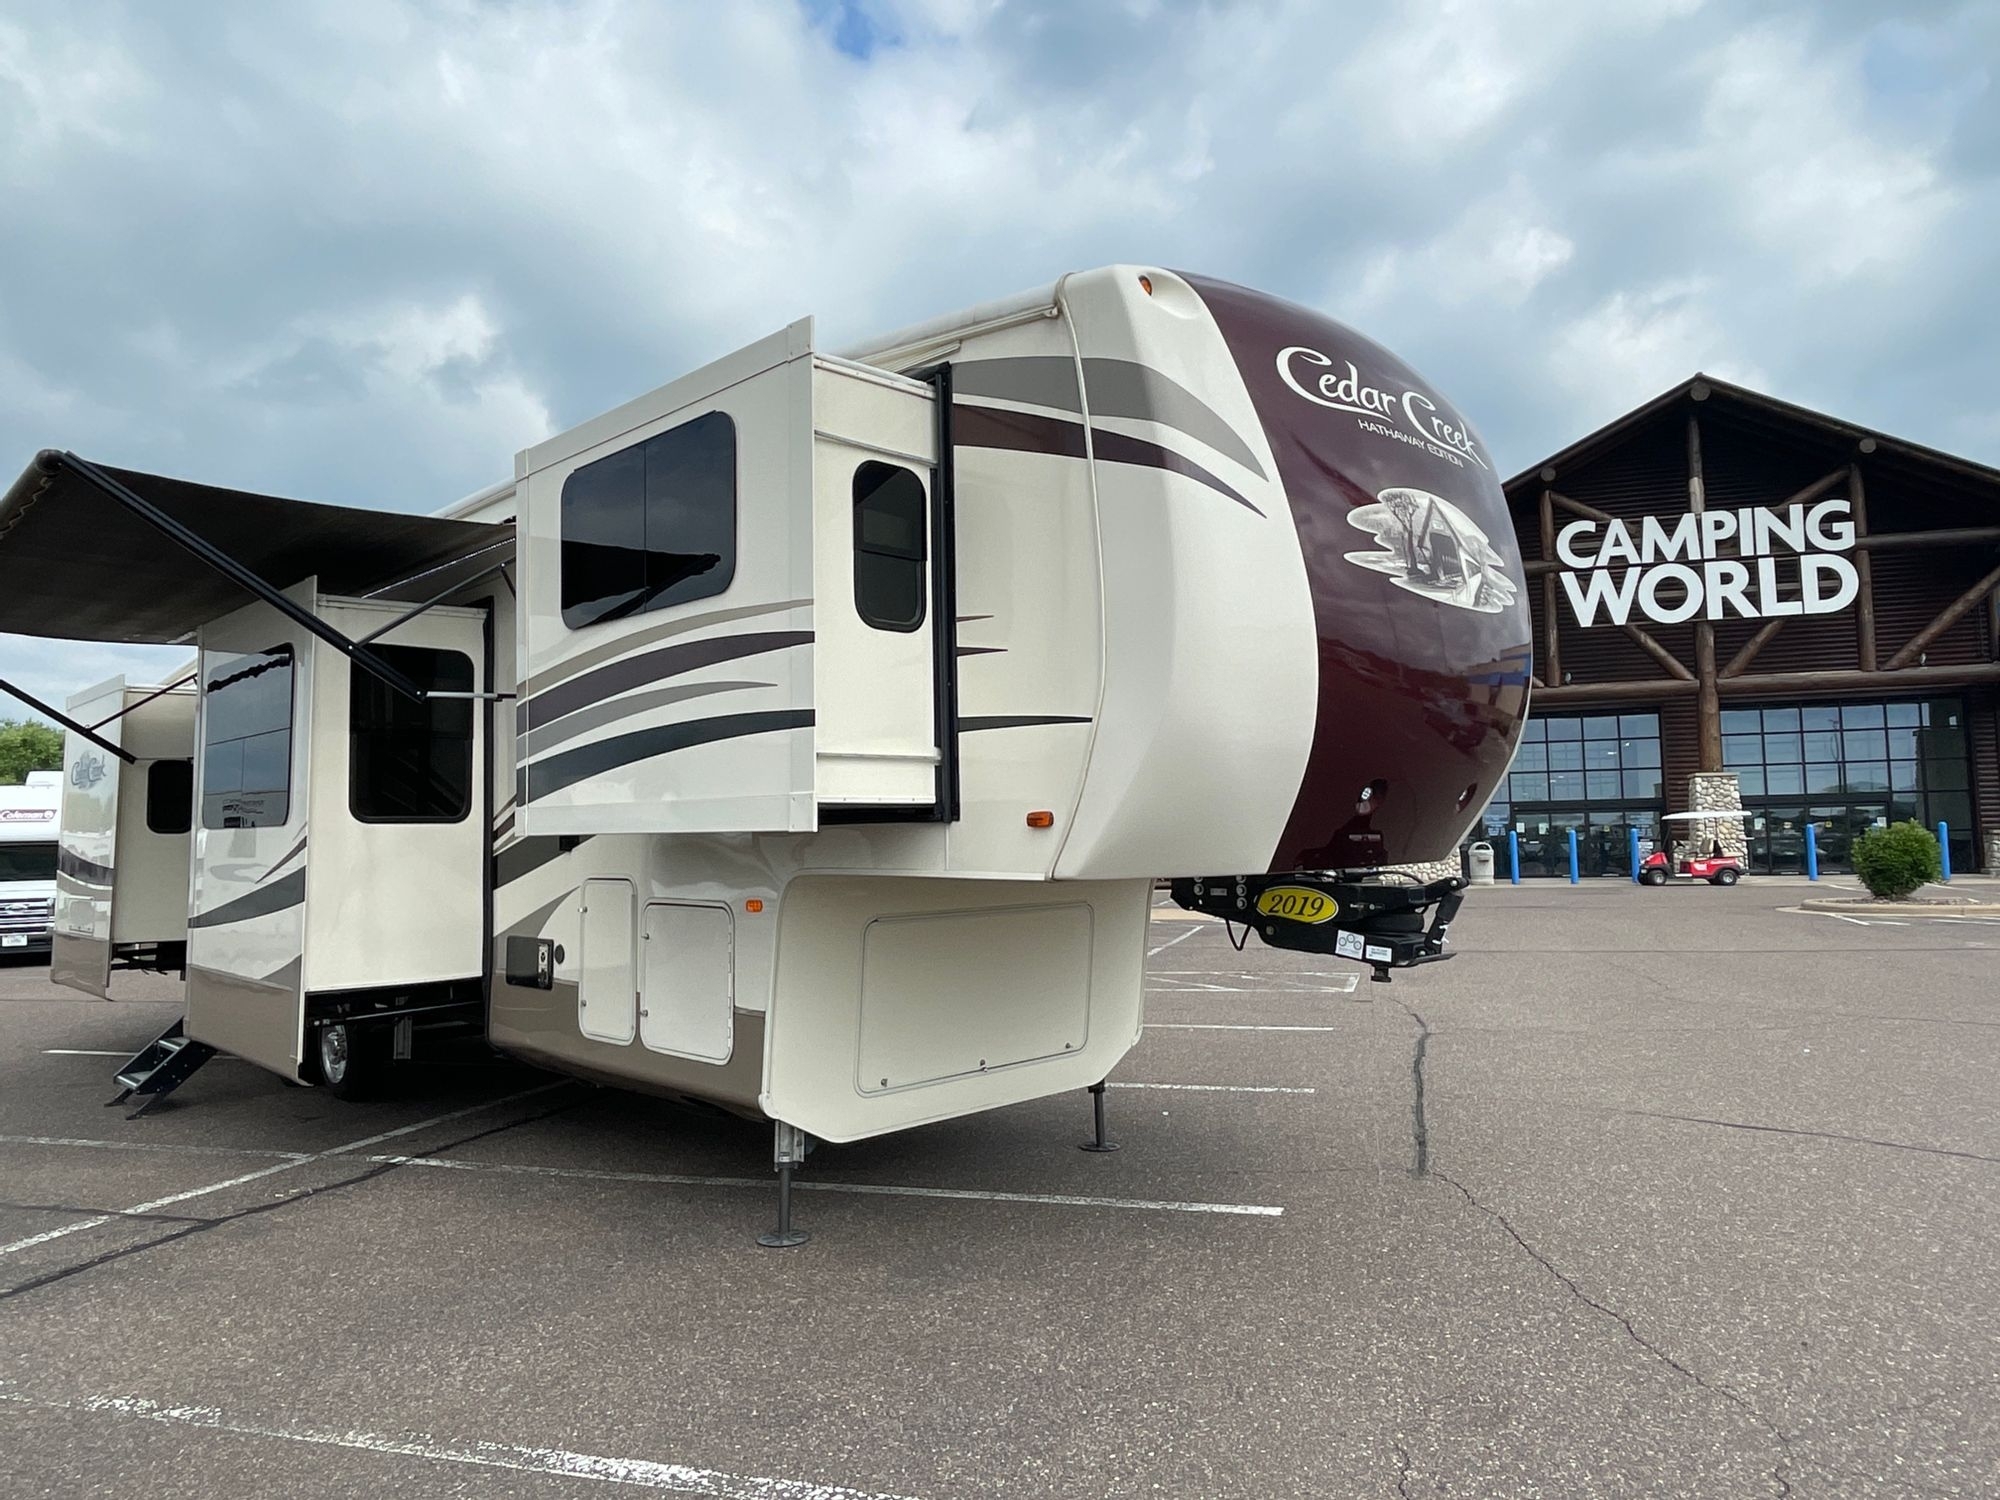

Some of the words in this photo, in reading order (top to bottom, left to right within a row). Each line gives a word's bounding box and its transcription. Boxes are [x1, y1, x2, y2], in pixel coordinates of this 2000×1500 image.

[1276, 346, 1396, 424] Cedar
[1402, 391, 1488, 470] Creek
[1357, 418, 1425, 449] HATHAWAY
[1556, 499, 1856, 569] CAMPING
[1559, 553, 1859, 628] WORLD
[1269, 894, 1325, 918] 2019
